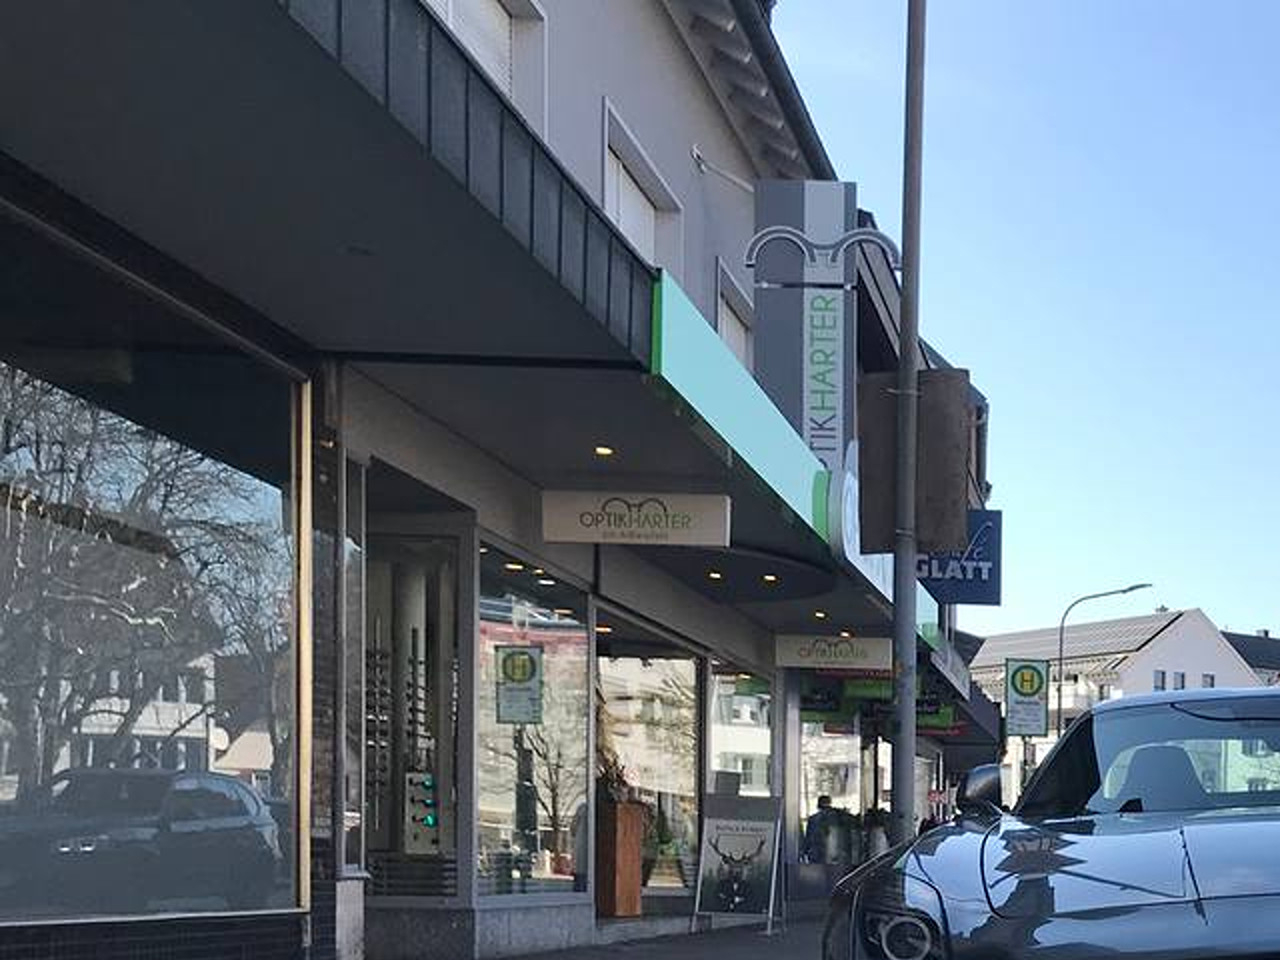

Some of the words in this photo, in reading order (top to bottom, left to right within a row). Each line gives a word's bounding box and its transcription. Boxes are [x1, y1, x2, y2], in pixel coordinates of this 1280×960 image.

[579, 511, 692, 529] OPTIKHARTER
[914, 553, 993, 581] GLATT
[1020, 671, 1035, 690] H
